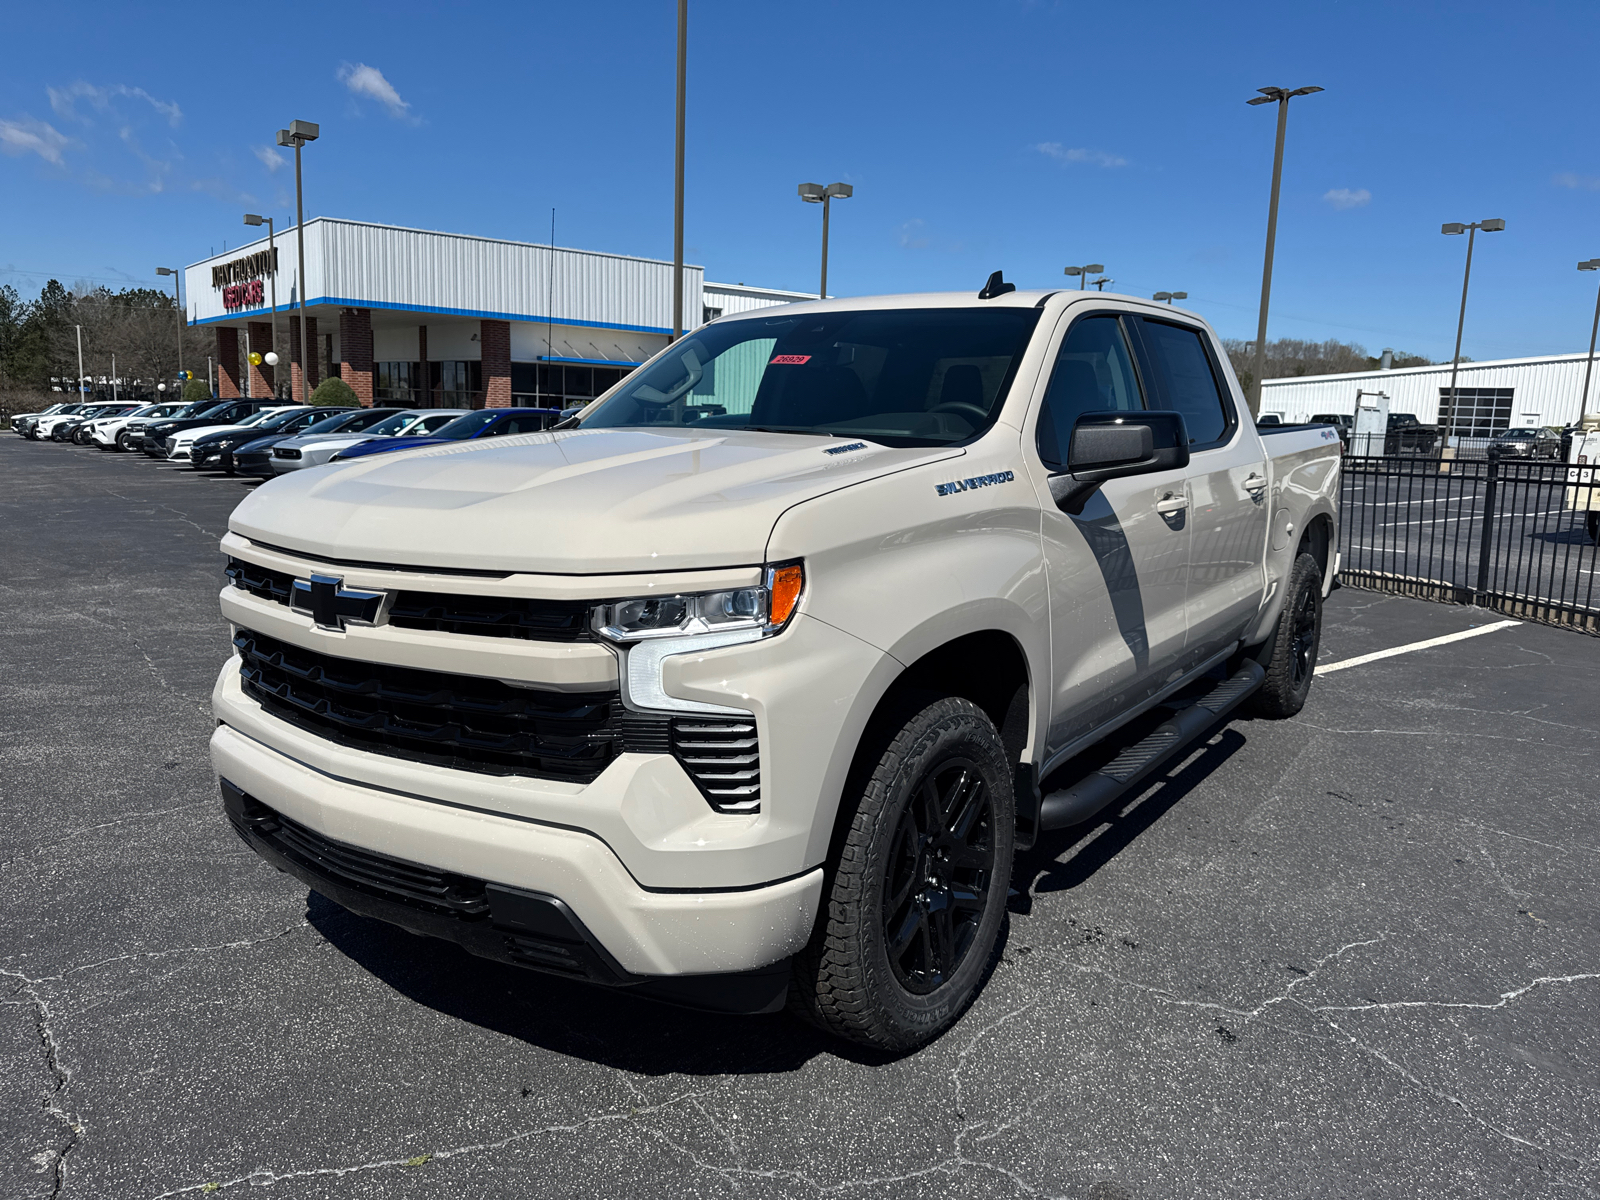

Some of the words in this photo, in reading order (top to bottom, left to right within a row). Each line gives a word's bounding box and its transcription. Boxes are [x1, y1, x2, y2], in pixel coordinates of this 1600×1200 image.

[211, 263, 231, 288] JOHN
[223, 285, 240, 309] USED
[241, 279, 262, 305] CARS
[935, 470, 1015, 497] SILVERADO
